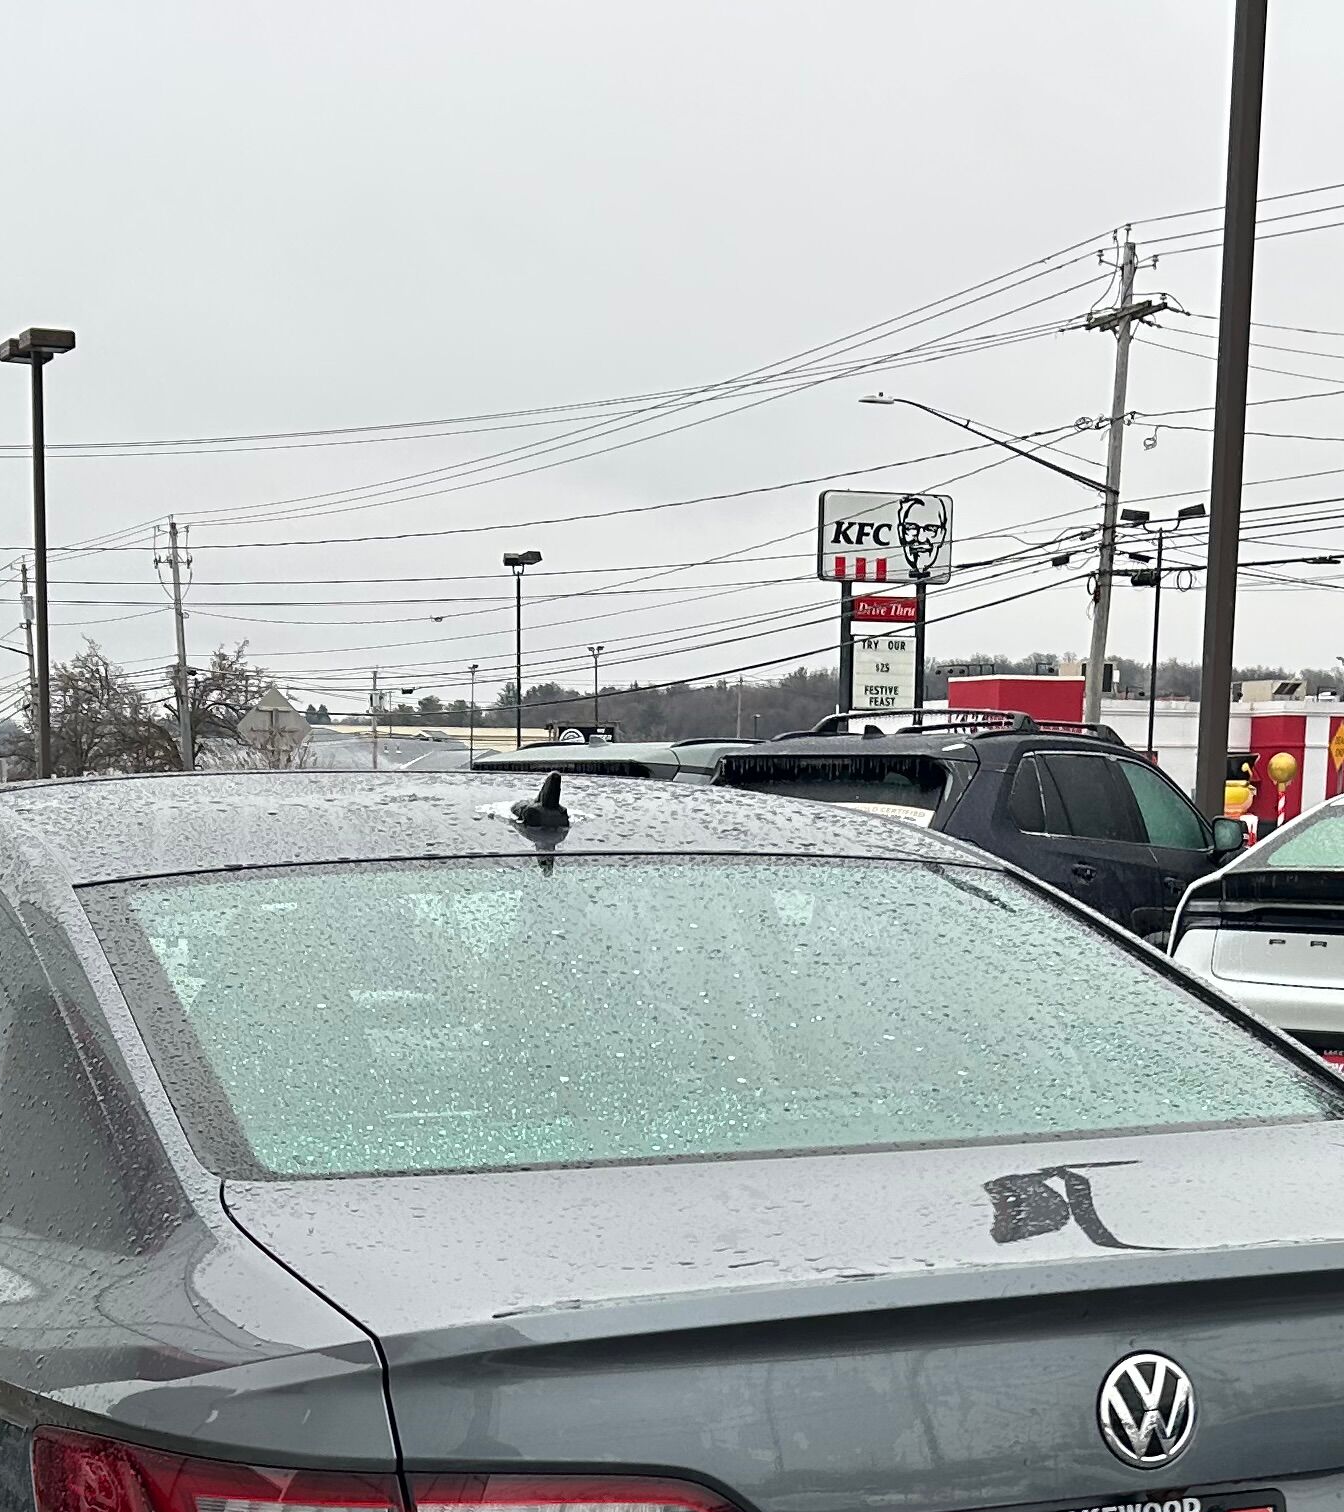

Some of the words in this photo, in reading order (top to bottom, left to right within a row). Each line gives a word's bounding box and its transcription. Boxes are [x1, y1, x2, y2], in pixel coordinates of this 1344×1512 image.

[831, 521, 892, 546] KFC
[858, 602, 887, 616] Drive
[890, 603, 916, 616] Thru
[862, 640, 880, 650] TRY
[887, 641, 906, 651] OUR
[875, 663, 890, 673] $25
[864, 685, 899, 696] FESTIVE
[869, 697, 896, 707] FEAST
